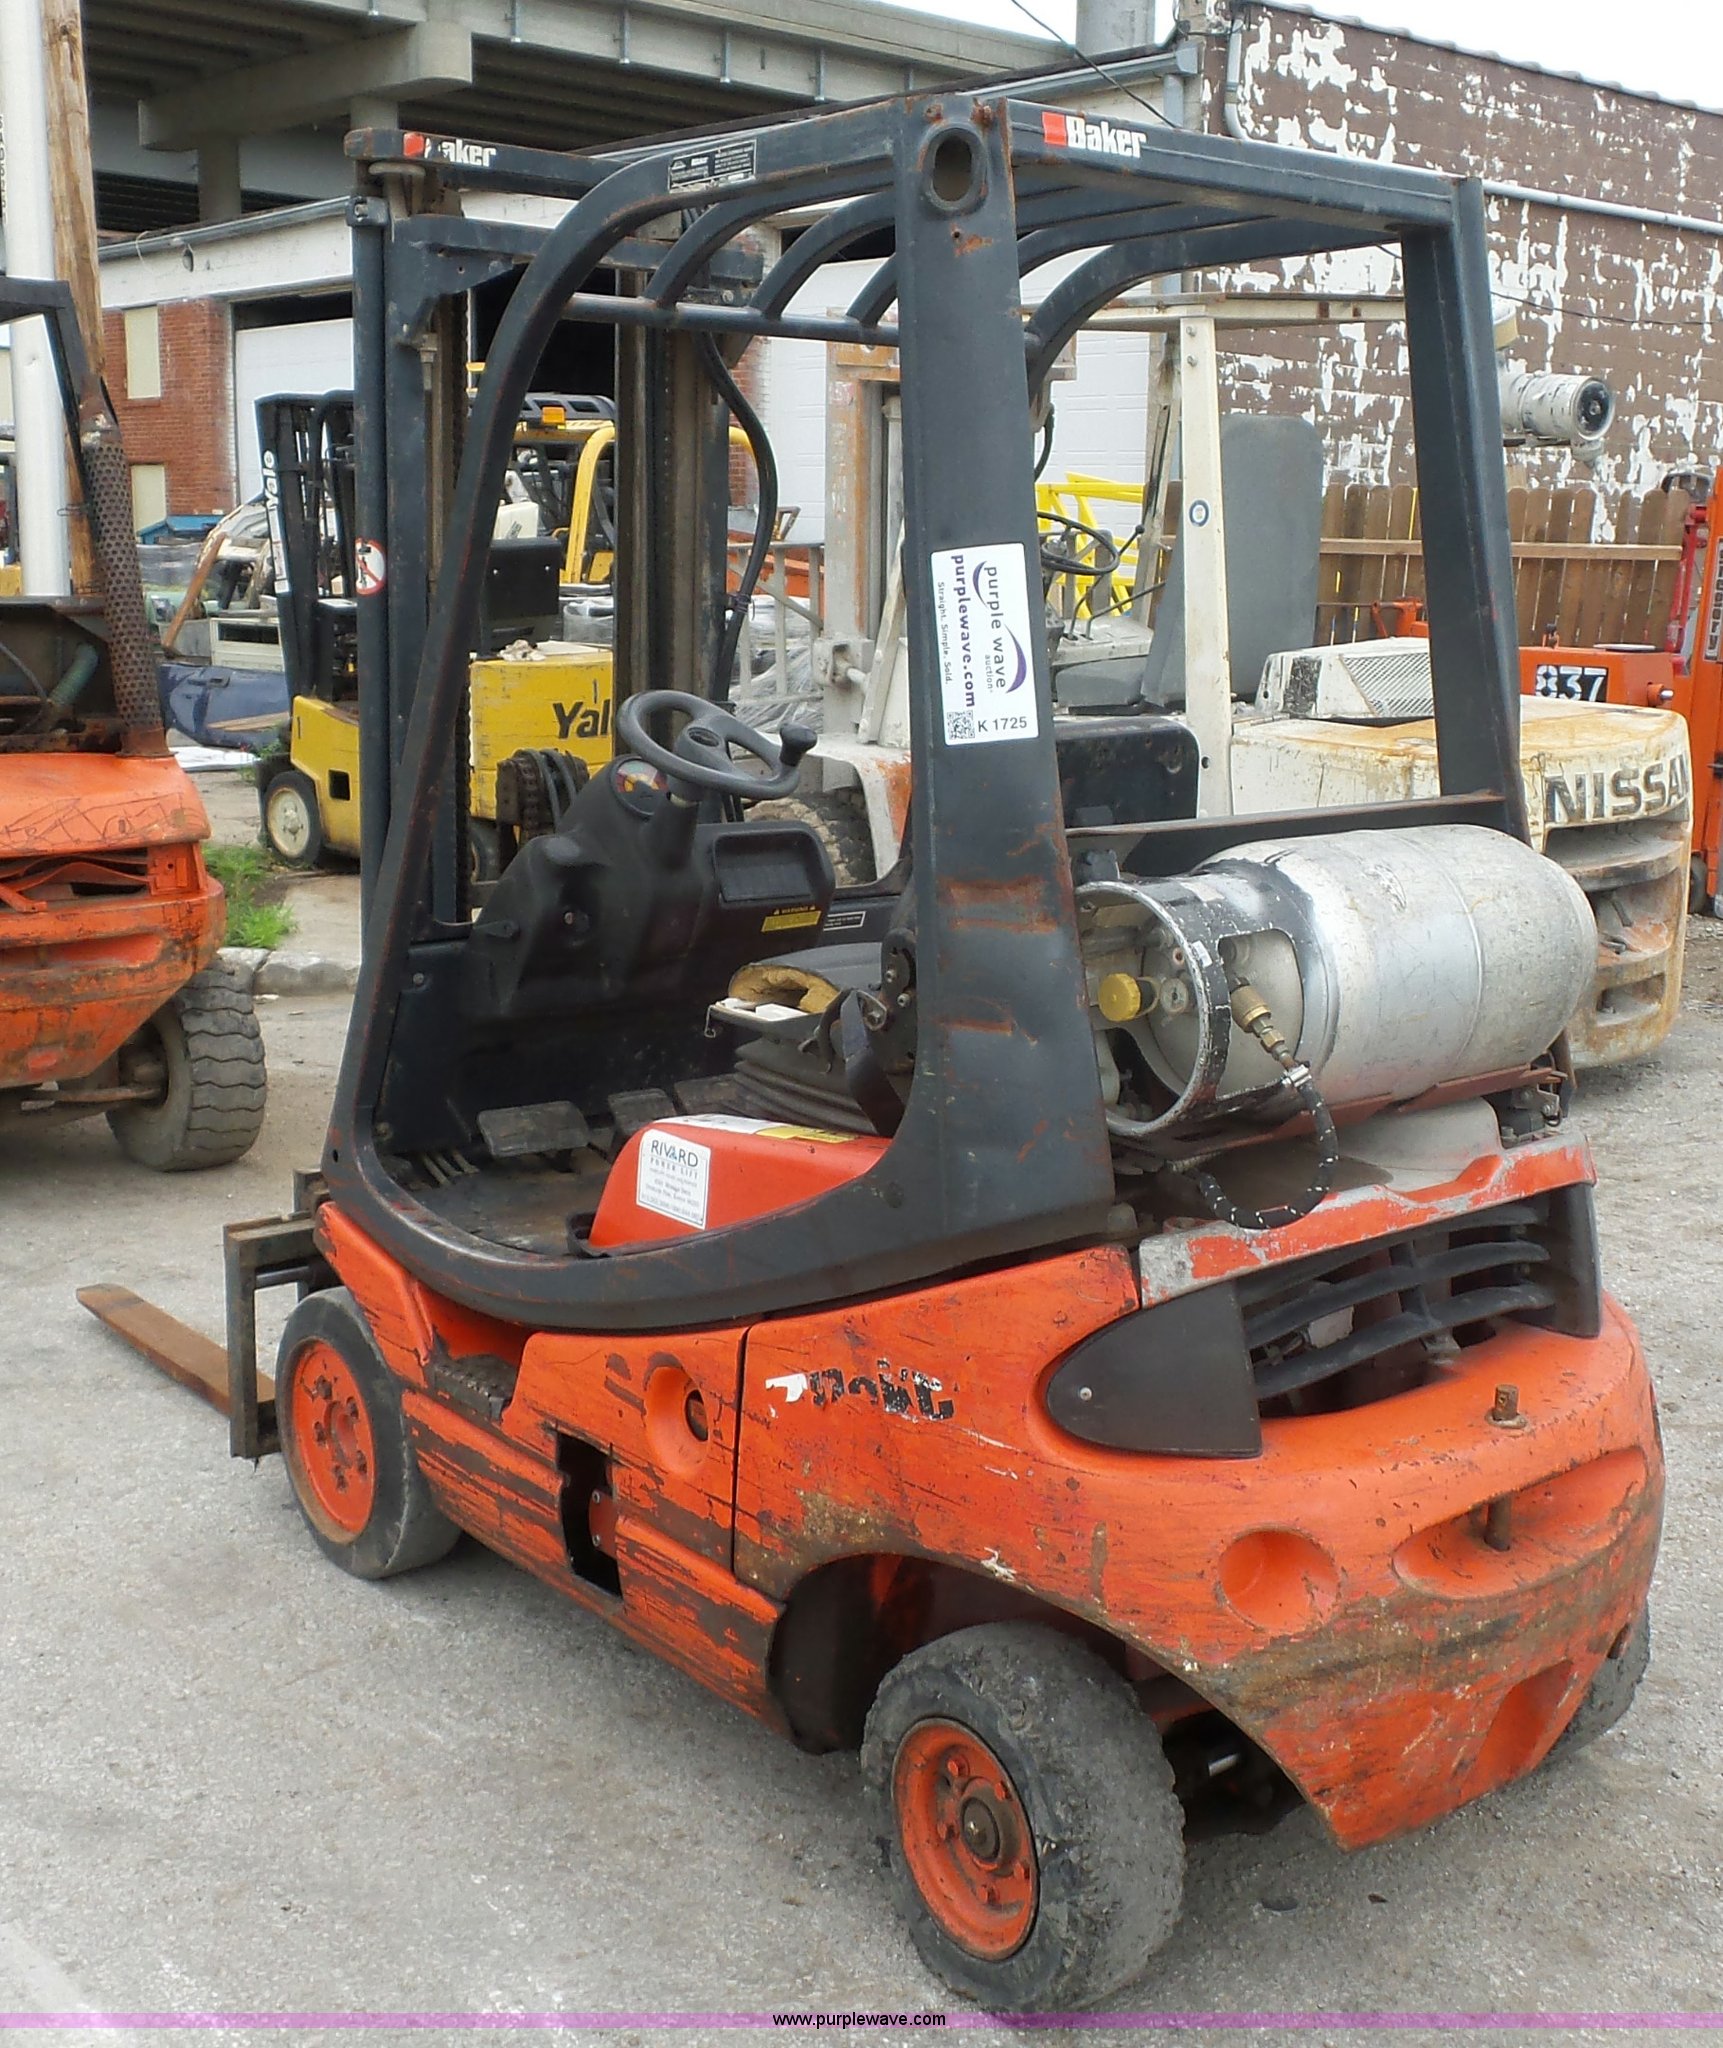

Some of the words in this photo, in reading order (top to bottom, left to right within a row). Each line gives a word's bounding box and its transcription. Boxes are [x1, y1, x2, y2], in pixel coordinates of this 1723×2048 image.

[424, 137, 497, 167] aker
[1065, 115, 1147, 158] Baker
[937, 581, 947, 622] Straight.
[983, 565, 1004, 630] purple
[940, 624, 949, 661] Simple.
[951, 554, 975, 708] purplewave.com
[944, 662, 953, 685] Sold.
[992, 637, 1006, 689] wave
[1536, 664, 1608, 702] 837
[552, 699, 611, 740] Yal
[977, 719, 988, 733] K
[992, 716, 1028, 731] 1725
